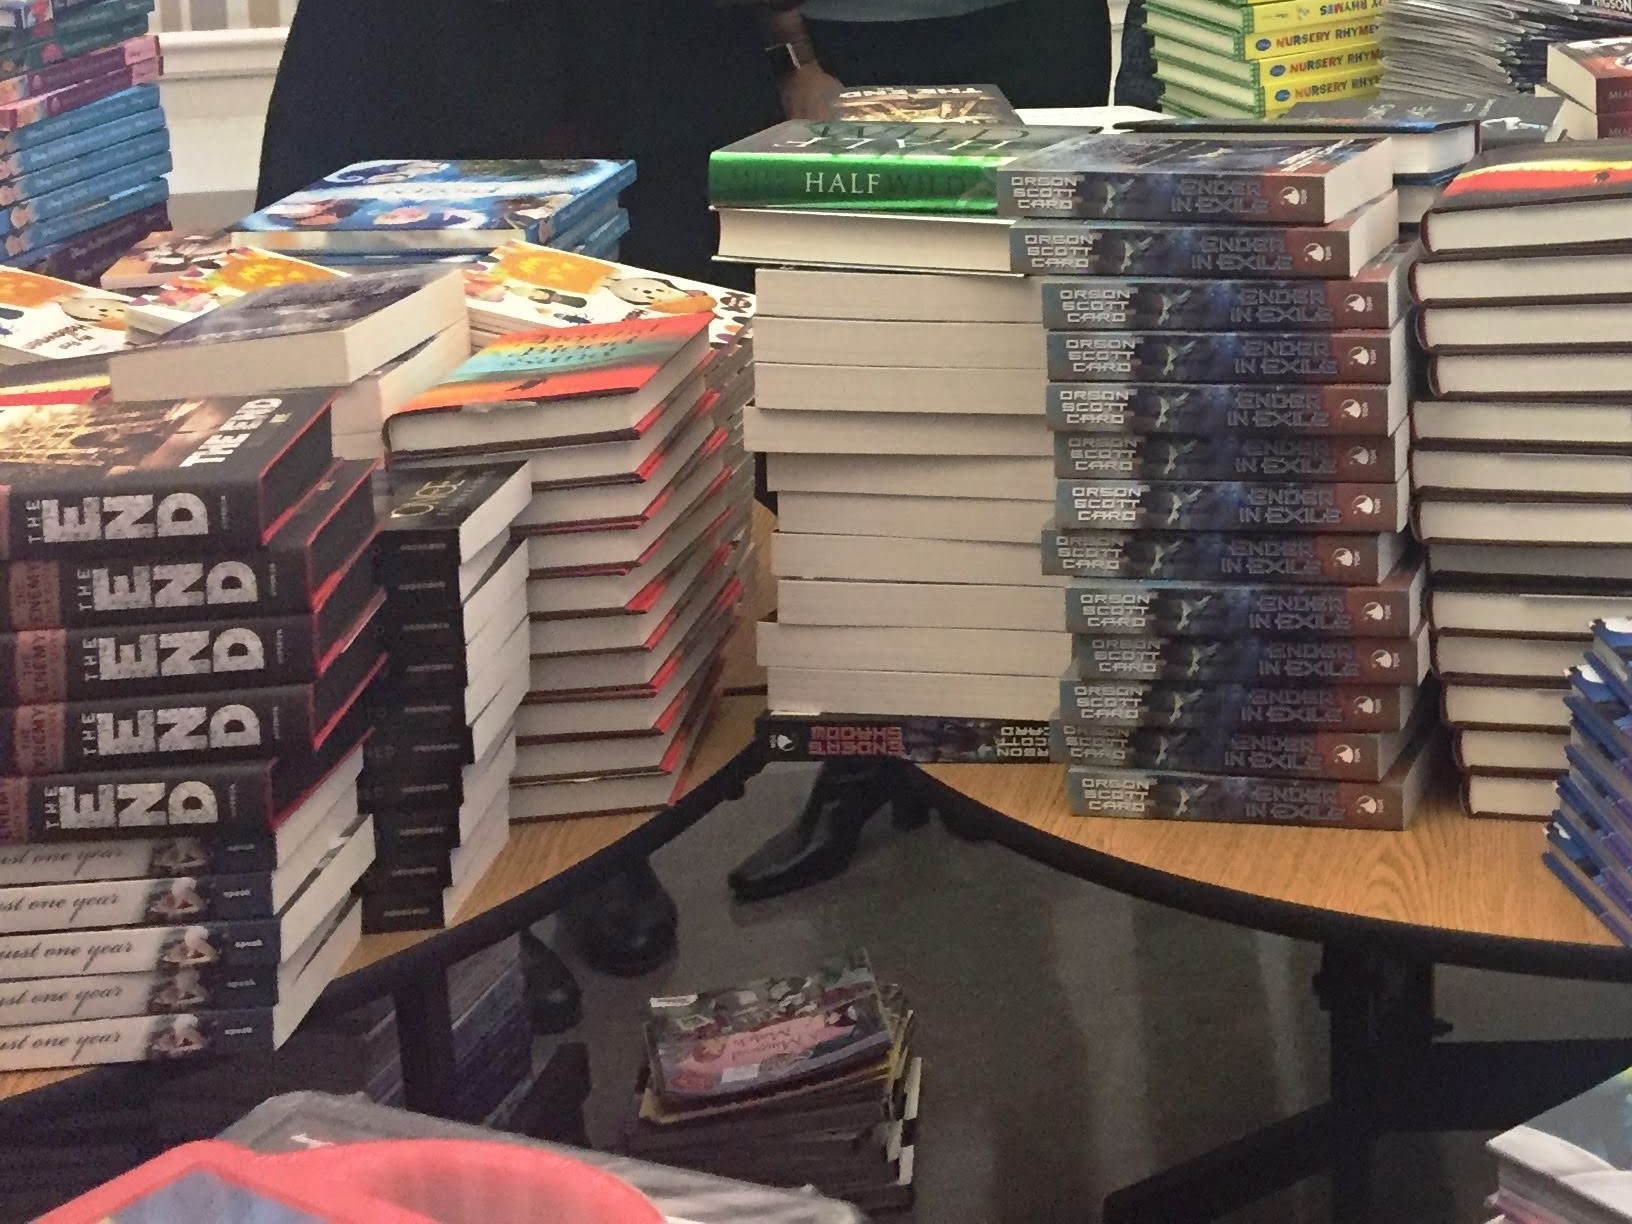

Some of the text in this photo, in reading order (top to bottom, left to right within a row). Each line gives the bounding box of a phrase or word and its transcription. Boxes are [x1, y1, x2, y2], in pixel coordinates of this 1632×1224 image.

[1320, 1, 1368, 16] RHYMES
[1276, 24, 1378, 48] NURSERY RHYME
[1290, 50, 1380, 74] NURSERY RHYM
[1295, 82, 1346, 98] NURSERY
[805, 172, 880, 194] HALF
[1011, 176, 1077, 187] ORSON
[1013, 188, 1076, 198] SCOTT
[1018, 199, 1073, 210] CARD
[1171, 198, 1268, 214] IN EXILE
[1025, 234, 1094, 245] ORSON
[1027, 247, 1092, 257] SCOTT
[1031, 258, 1089, 268] CARD
[1192, 255, 1292, 271] IN EXILE
[1060, 289, 1131, 300] ORSON
[1062, 301, 1129, 311] SCOTT
[1067, 312, 1126, 323] CARD
[1230, 306, 1334, 324] IN EXILE
[1066, 339, 1136, 349] ORSON
[1068, 351, 1134, 361] SCOTT
[1073, 362, 1131, 373] CARD
[1235, 359, 1338, 375] IN EXILE
[1060, 390, 1129, 401] ORSON
[1062, 402, 1128, 412] SCOTT
[1066, 414, 1124, 424] CARD
[1228, 411, 1329, 427] IN EXILE
[179, 398, 282, 468] THE END
[1072, 487, 1141, 497] ORSON
[1074, 499, 1139, 509] SCOTT
[25, 492, 208, 544] THE END
[1078, 511, 1136, 521] CARD
[1239, 508, 1341, 524] IN EXILE
[77, 561, 258, 612] THE END
[1080, 594, 1150, 604] ORSON
[1083, 606, 1149, 616] SCOTT
[1087, 617, 1145, 627] CARD
[1249, 614, 1351, 630] IN EXILE
[1092, 640, 1161, 649] ORSON
[83, 627, 265, 682] THE END
[1094, 651, 1160, 661] SCOTT
[1099, 662, 1157, 672] CARD
[1074, 686, 1144, 696] ORSON
[1076, 698, 1142, 708] SCOTT
[1081, 709, 1139, 719] CARD
[81, 712, 97, 756] THE
[97, 704, 261, 756] END
[996, 736, 1049, 746] COTT
[997, 746, 1049, 757] RSON
[1082, 778, 1150, 788] ORSON
[1084, 790, 1149, 800] SCOTT
[44, 786, 59, 830] THE
[59, 780, 218, 830] END
[1088, 801, 1145, 812] CARD
[0, 849, 122, 877] ust one year
[0, 894, 118, 923] ust one year
[44, 946, 81, 957] one
[83, 942, 134, 972] year
[0, 988, 123, 1017] ust one year
[0, 1032, 121, 1062] ust one year
